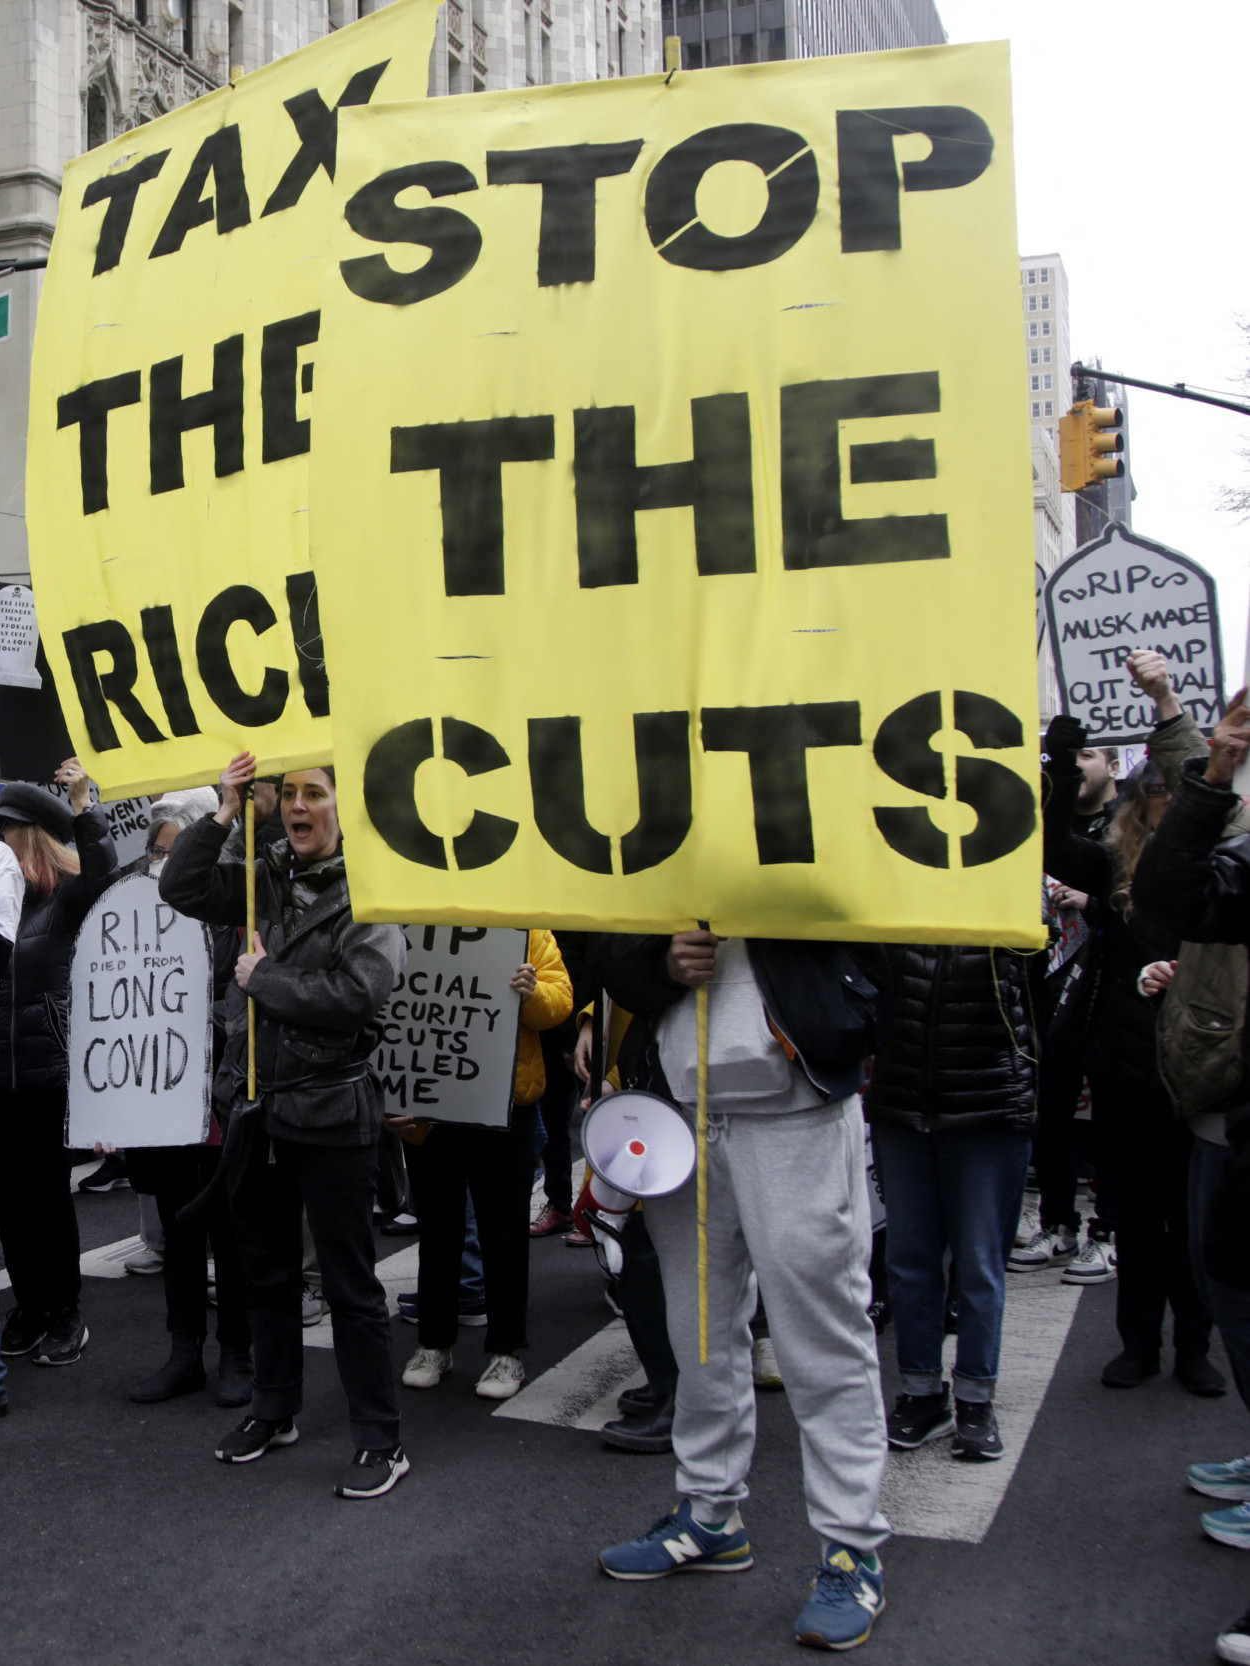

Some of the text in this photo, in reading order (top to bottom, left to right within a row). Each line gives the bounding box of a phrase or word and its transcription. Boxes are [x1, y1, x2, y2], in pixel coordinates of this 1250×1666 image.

[81, 58, 392, 278] TAX
[339, 105, 995, 307] STOP
[389, 370, 952, 599] THE
[1087, 565, 1151, 597] RIP
[1062, 602, 1211, 643] MUSK MADE
[1088, 638, 1207, 671] TRMP
[1069, 679, 1125, 705] CUT
[1085, 698, 1220, 734] SECUTY
[363, 690, 1037, 876] CUTS
[90, 955, 184, 973] DIED FROM
[88, 967, 189, 1022] LONG
[392, 971, 493, 1000] CIAL
[375, 1000, 501, 1032] ECURITY
[382, 1023, 469, 1055] CUTS
[83, 1027, 189, 1094] COVID
[377, 1049, 480, 1081] ILLED
[383, 1074, 440, 1109] ME
